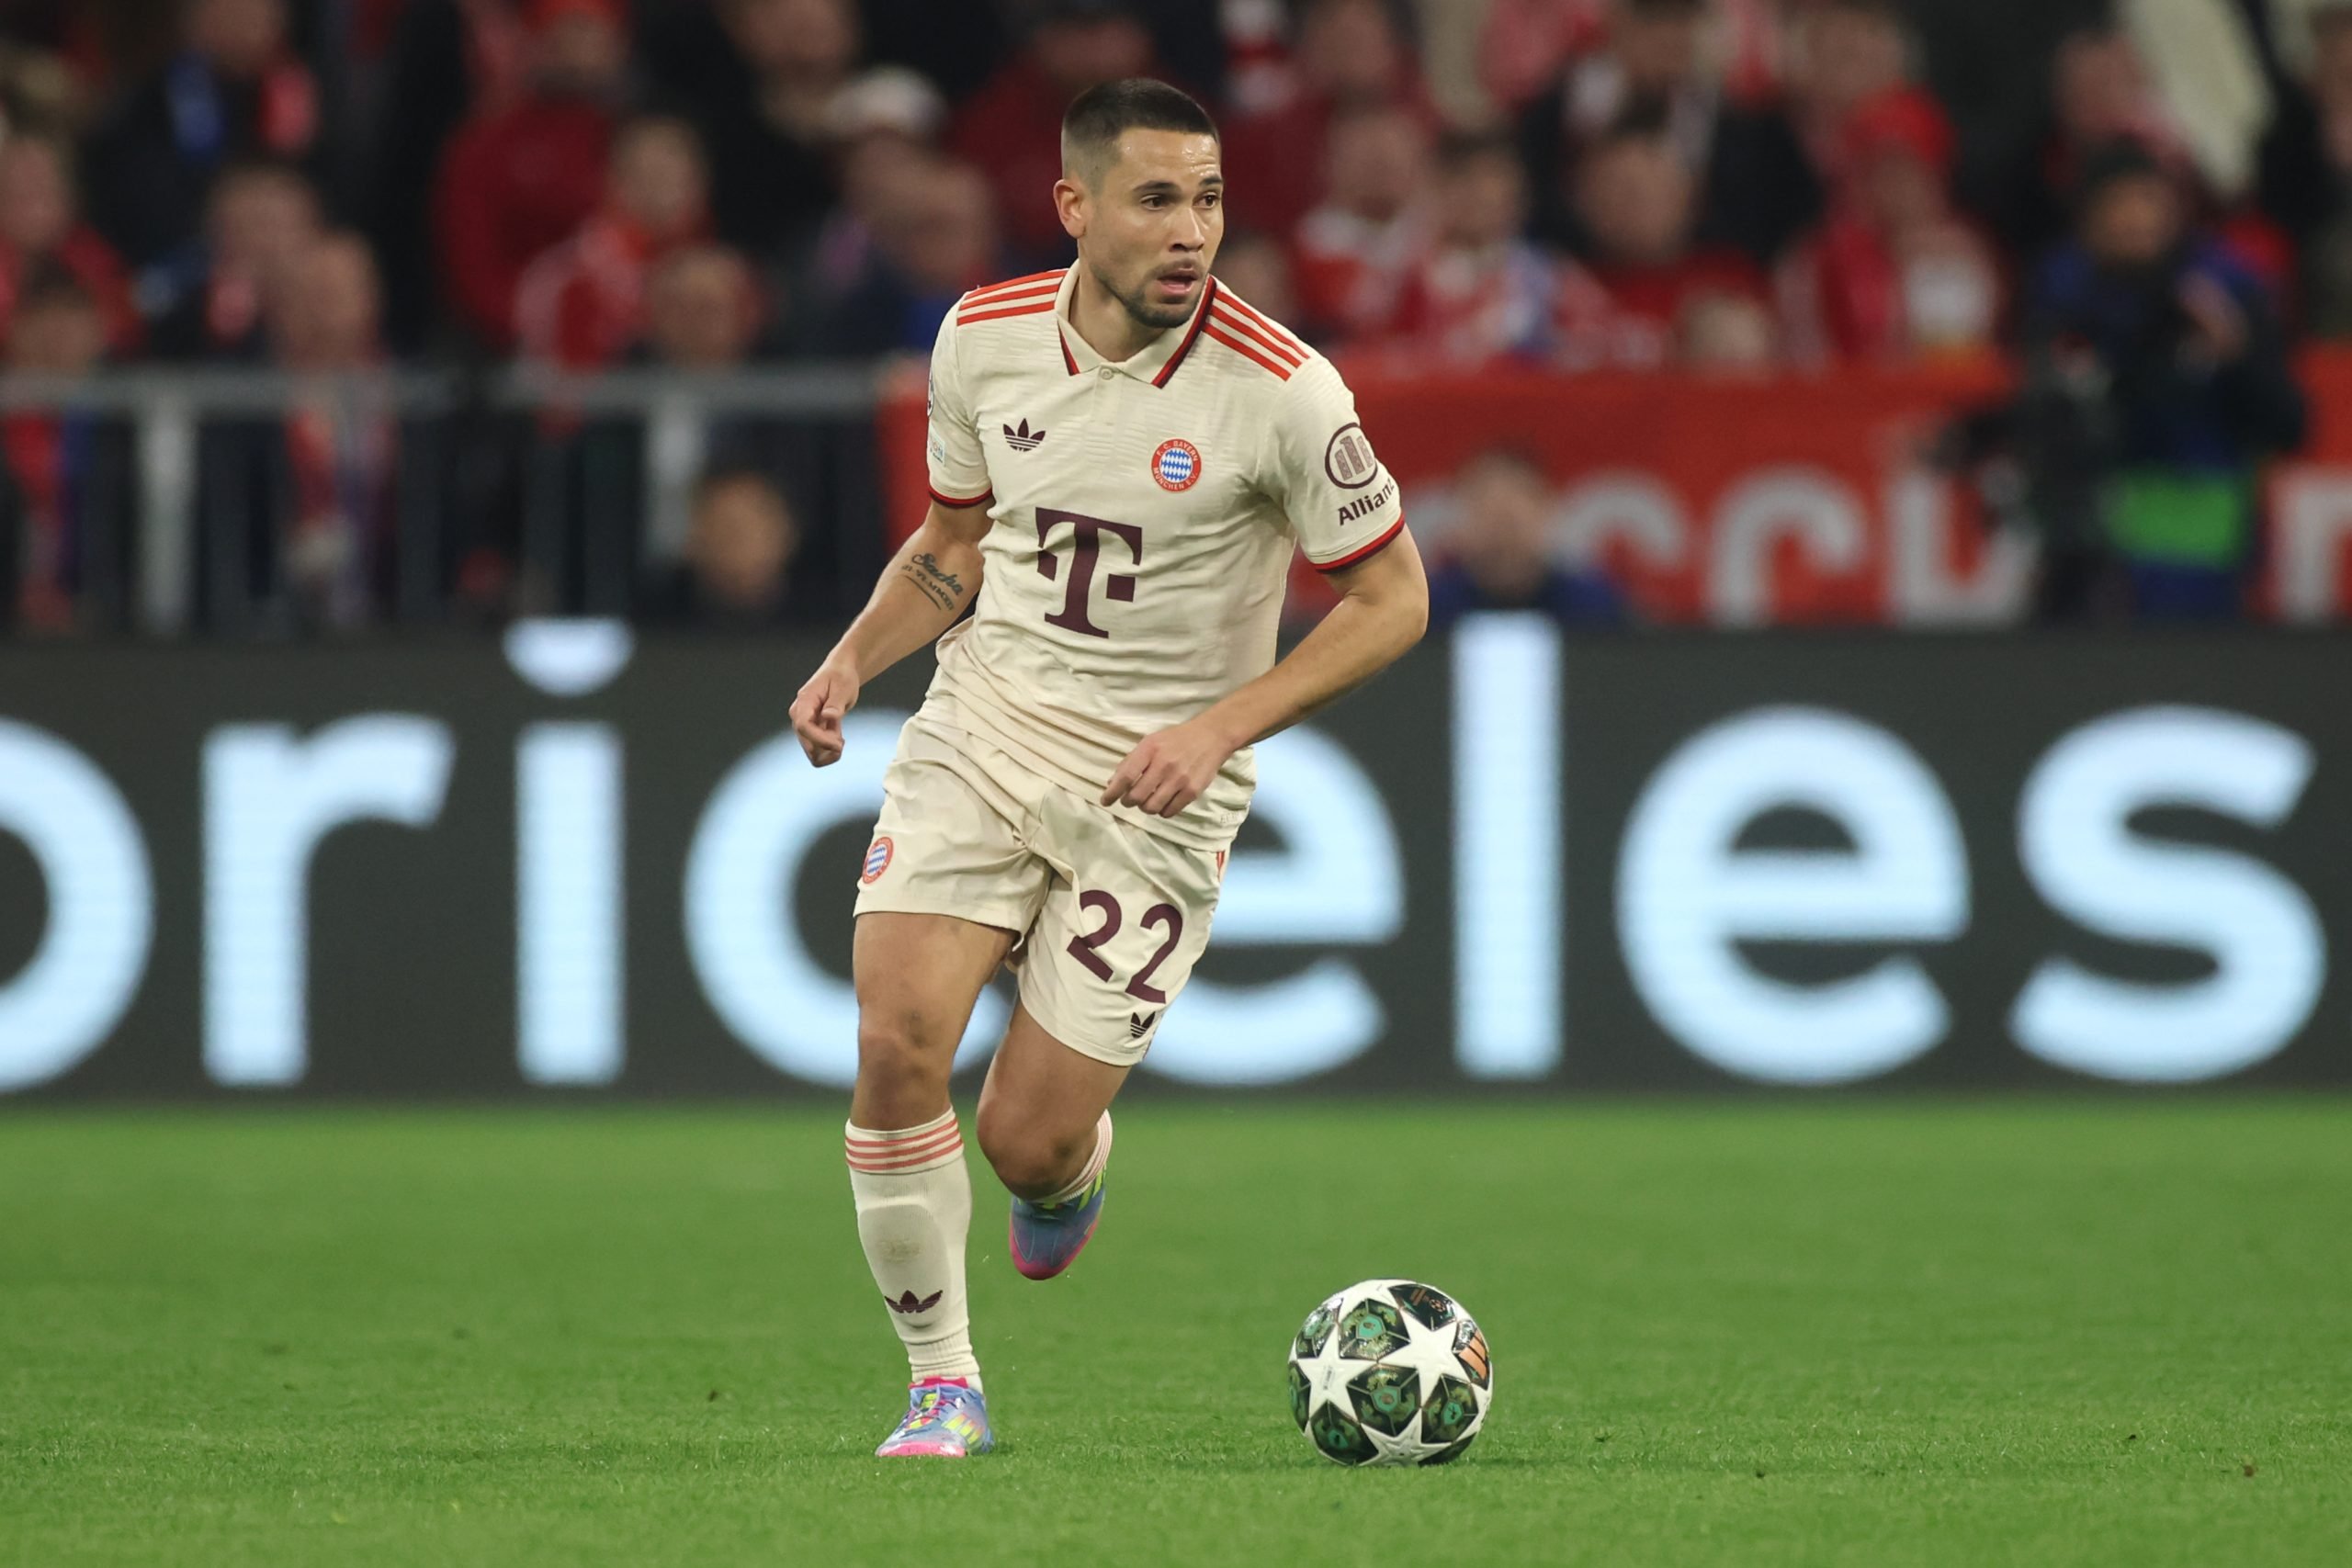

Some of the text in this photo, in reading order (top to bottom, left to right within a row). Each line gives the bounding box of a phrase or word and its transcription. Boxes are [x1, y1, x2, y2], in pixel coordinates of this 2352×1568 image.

[1172, 440, 1199, 462] BAYERN
[1035, 506, 1143, 639] T
[1067, 889, 1183, 1004] 22
